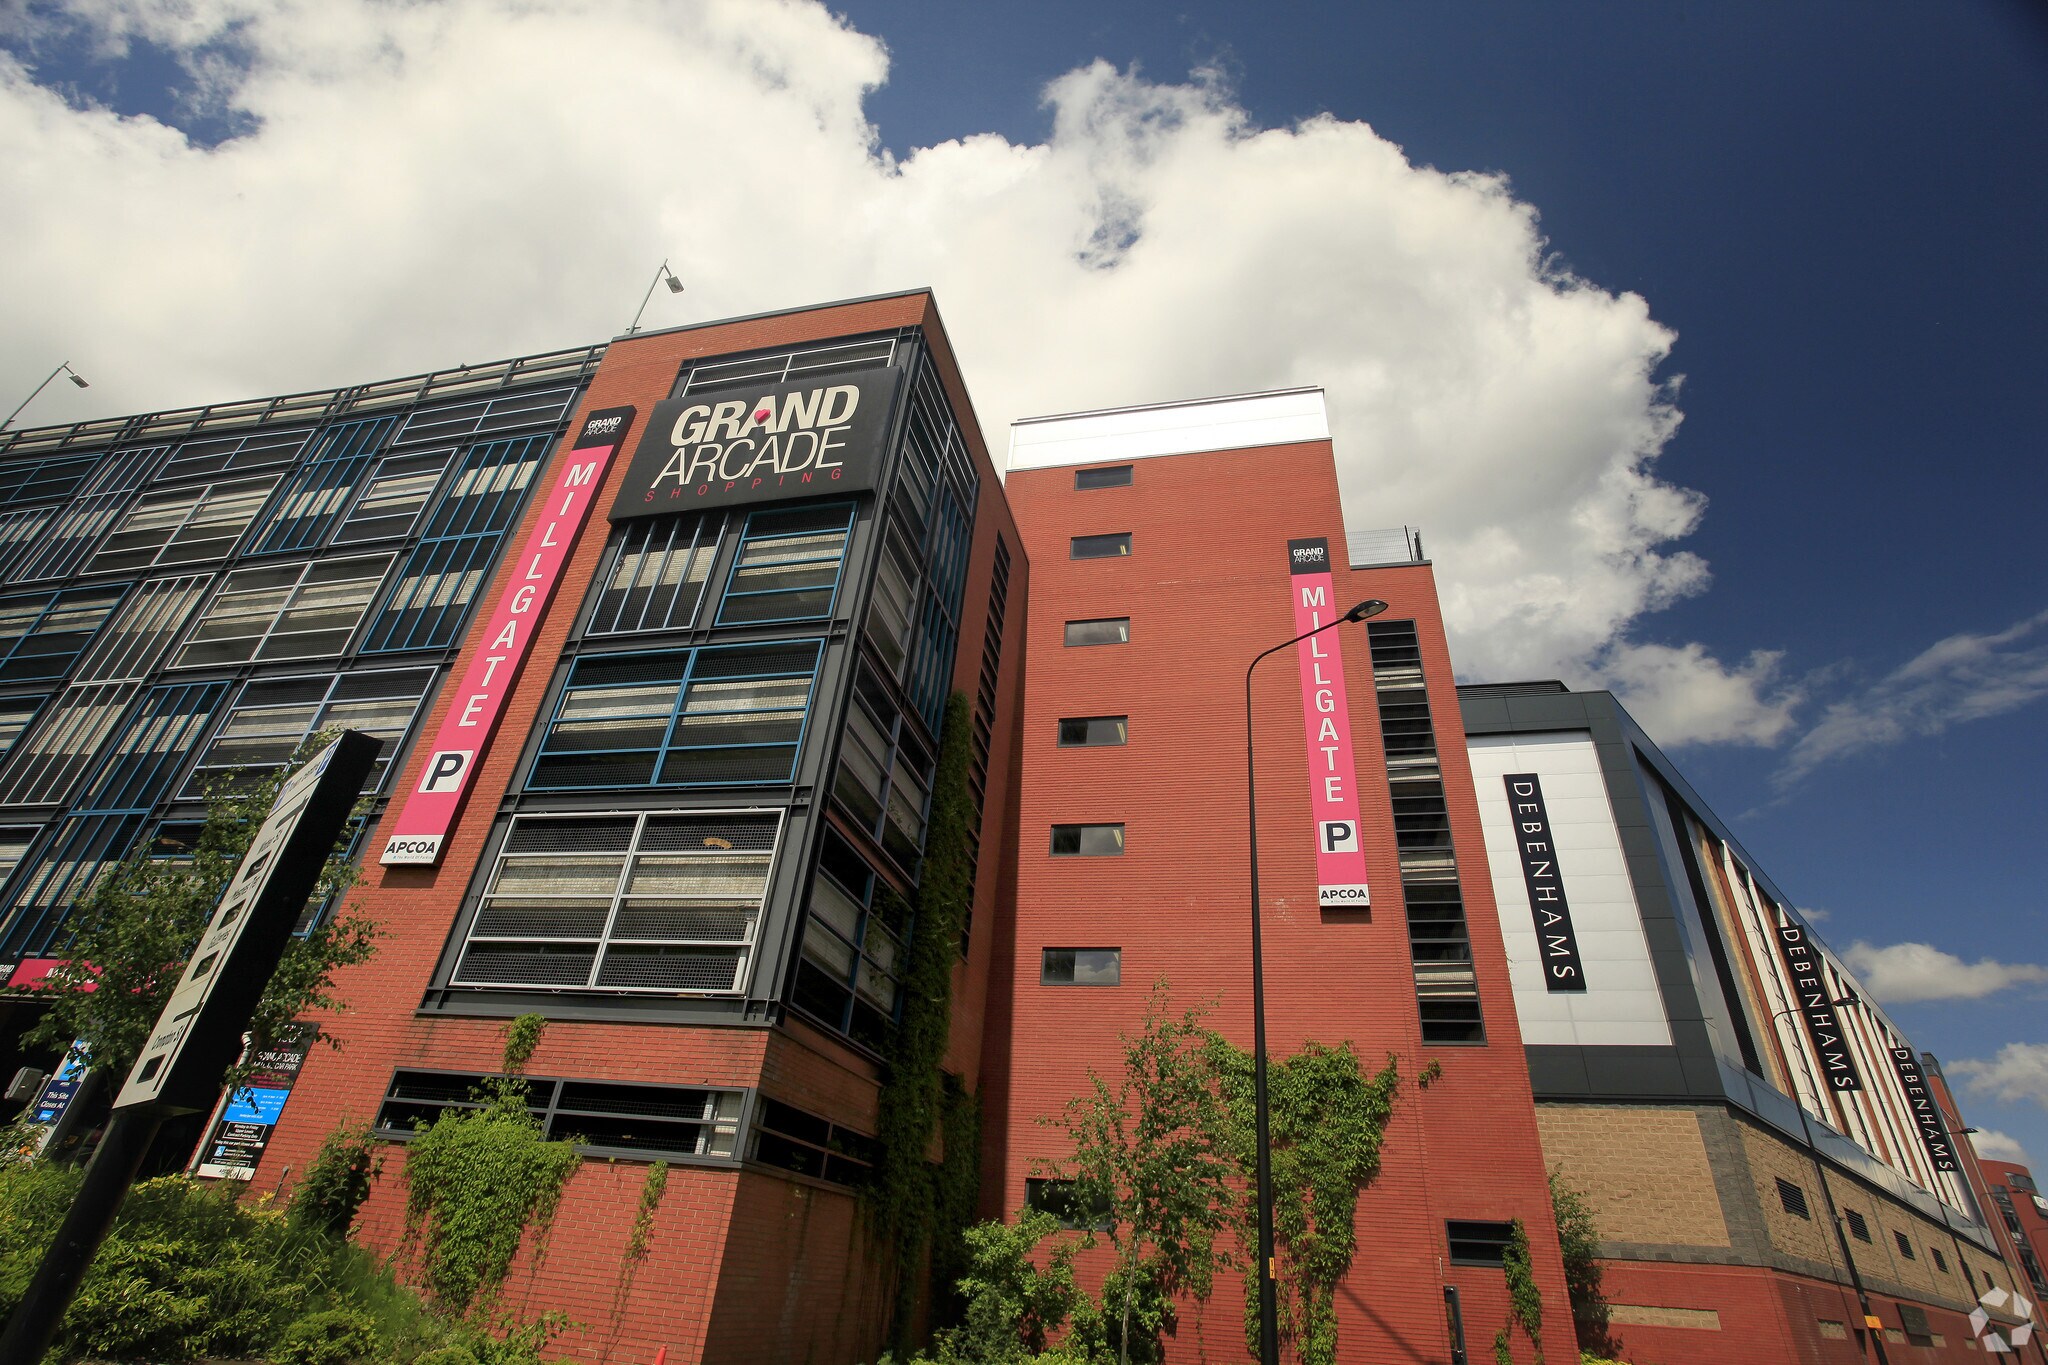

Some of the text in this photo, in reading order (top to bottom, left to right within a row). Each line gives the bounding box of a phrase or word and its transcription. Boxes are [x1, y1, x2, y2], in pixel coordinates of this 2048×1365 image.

[583, 424, 617, 437] ARCADE
[588, 416, 622, 428] GRAND
[670, 384, 860, 447] GRAND
[650, 425, 851, 489] ARCADE
[644, 468, 842, 502] SHOPPING
[1293, 547, 1324, 557] GRAND
[1294, 554, 1325, 563] ARCADE
[457, 461, 597, 728] MILLGATE
[1302, 586, 1344, 803] MILLGATE
[426, 753, 464, 792] P
[385, 841, 436, 854] APCOA
[1326, 822, 1352, 852] P
[1320, 889, 1367, 899] APCOA
[1513, 782, 1575, 980] DEBENHAMS
[1781, 928, 1854, 1091] DEBENHAMS
[151, 1030, 177, 1051] Crompton
[46, 1091, 69, 1100] This Site
[1894, 1047, 1953, 1172] DEBENHAMS
